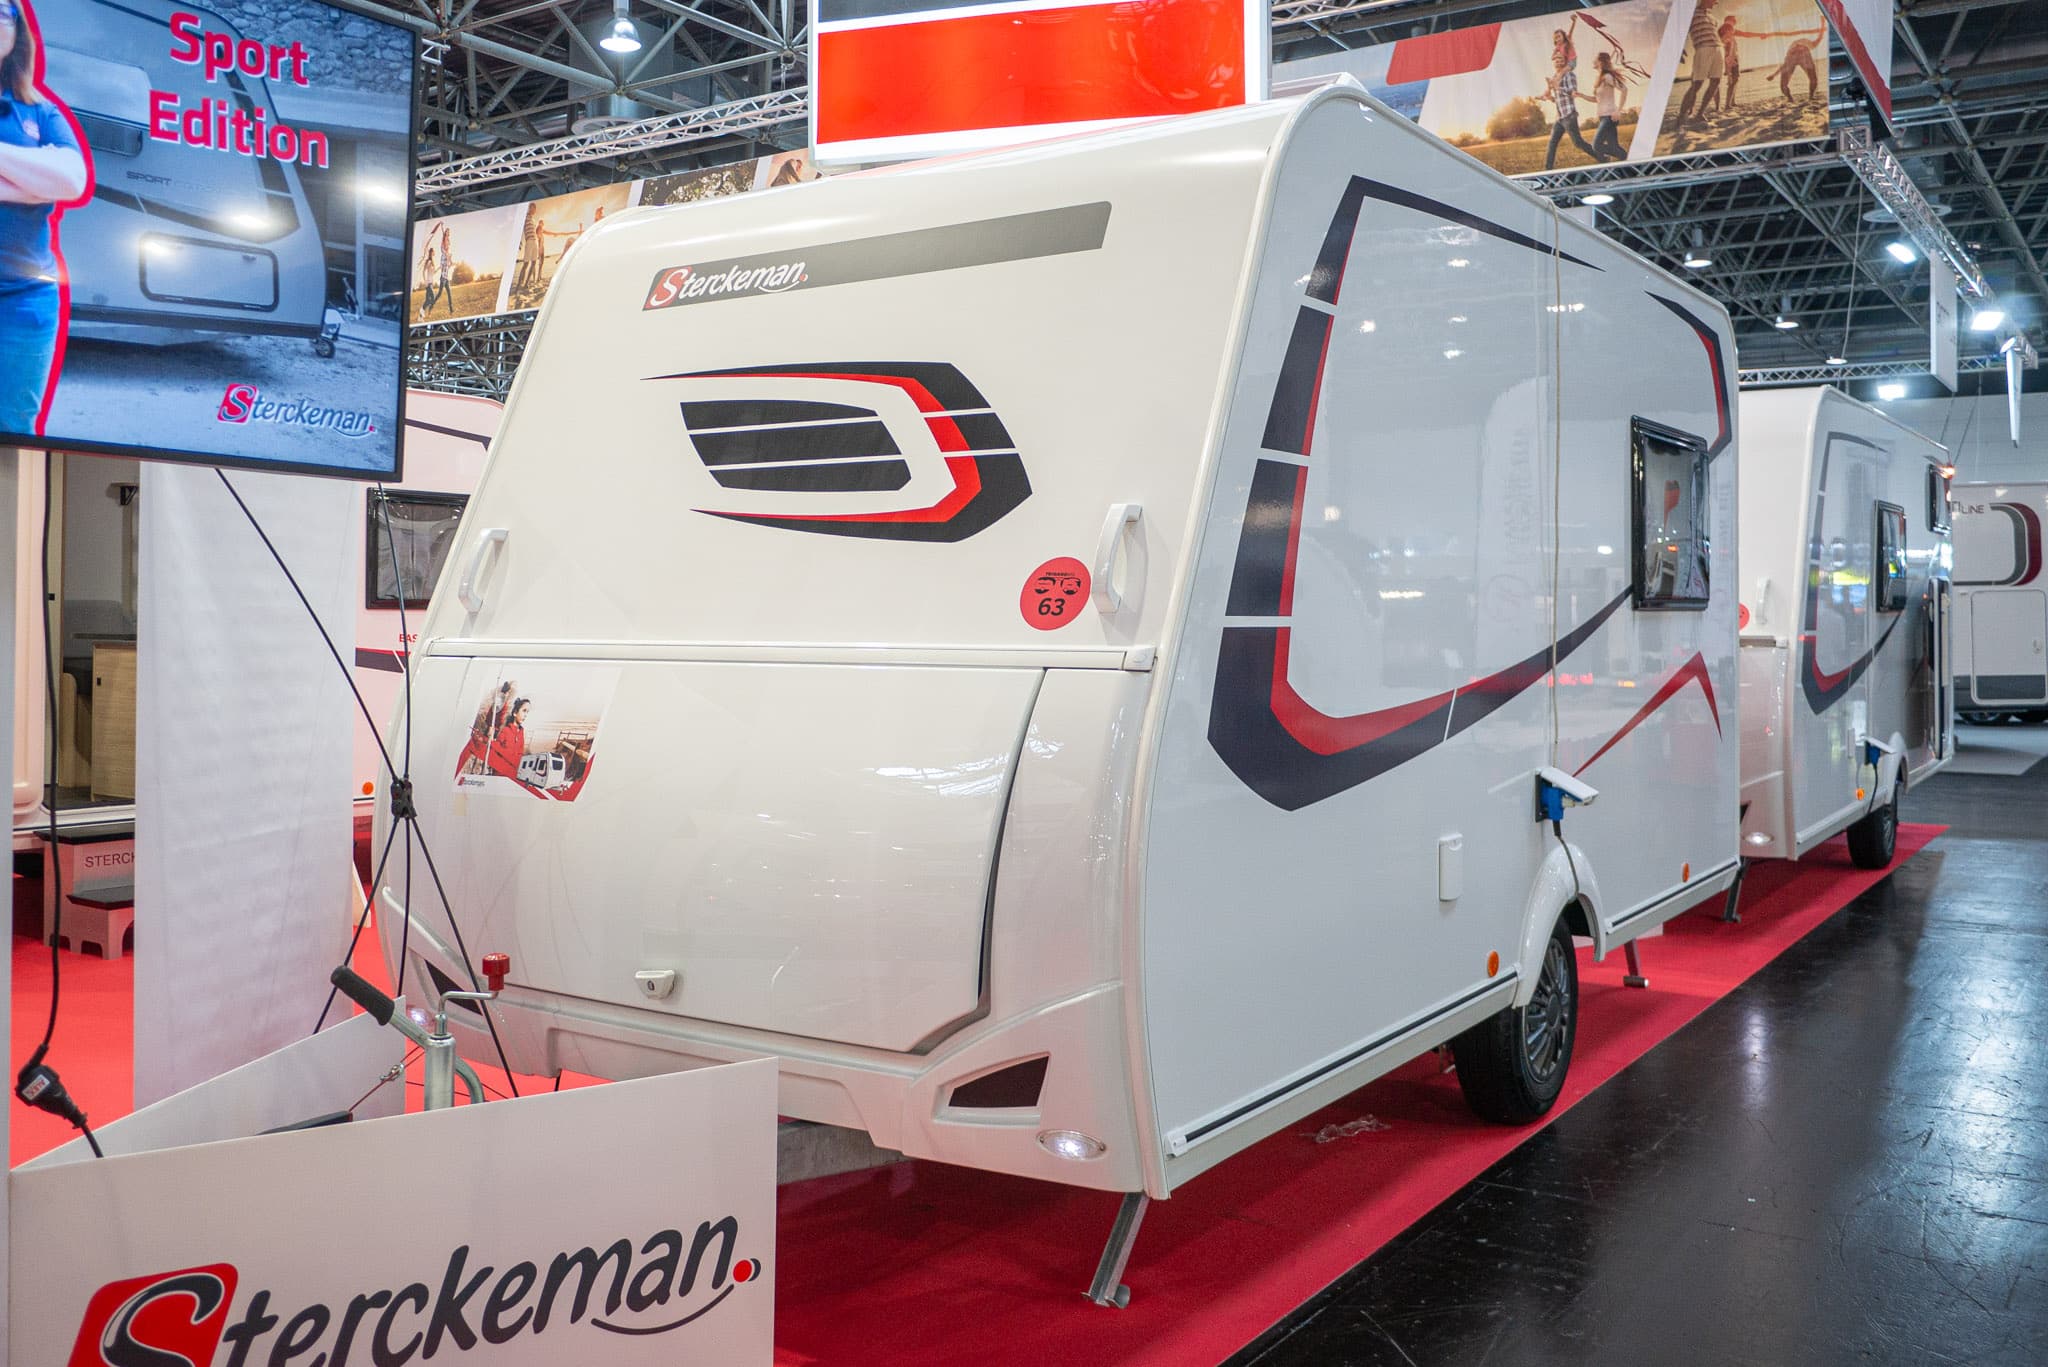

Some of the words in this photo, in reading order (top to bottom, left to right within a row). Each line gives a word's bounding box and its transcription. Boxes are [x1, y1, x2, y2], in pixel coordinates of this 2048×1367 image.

[170, 12, 309, 86] Sport
[149, 89, 329, 168] Edition
[1038, 597, 1066, 616] 63
